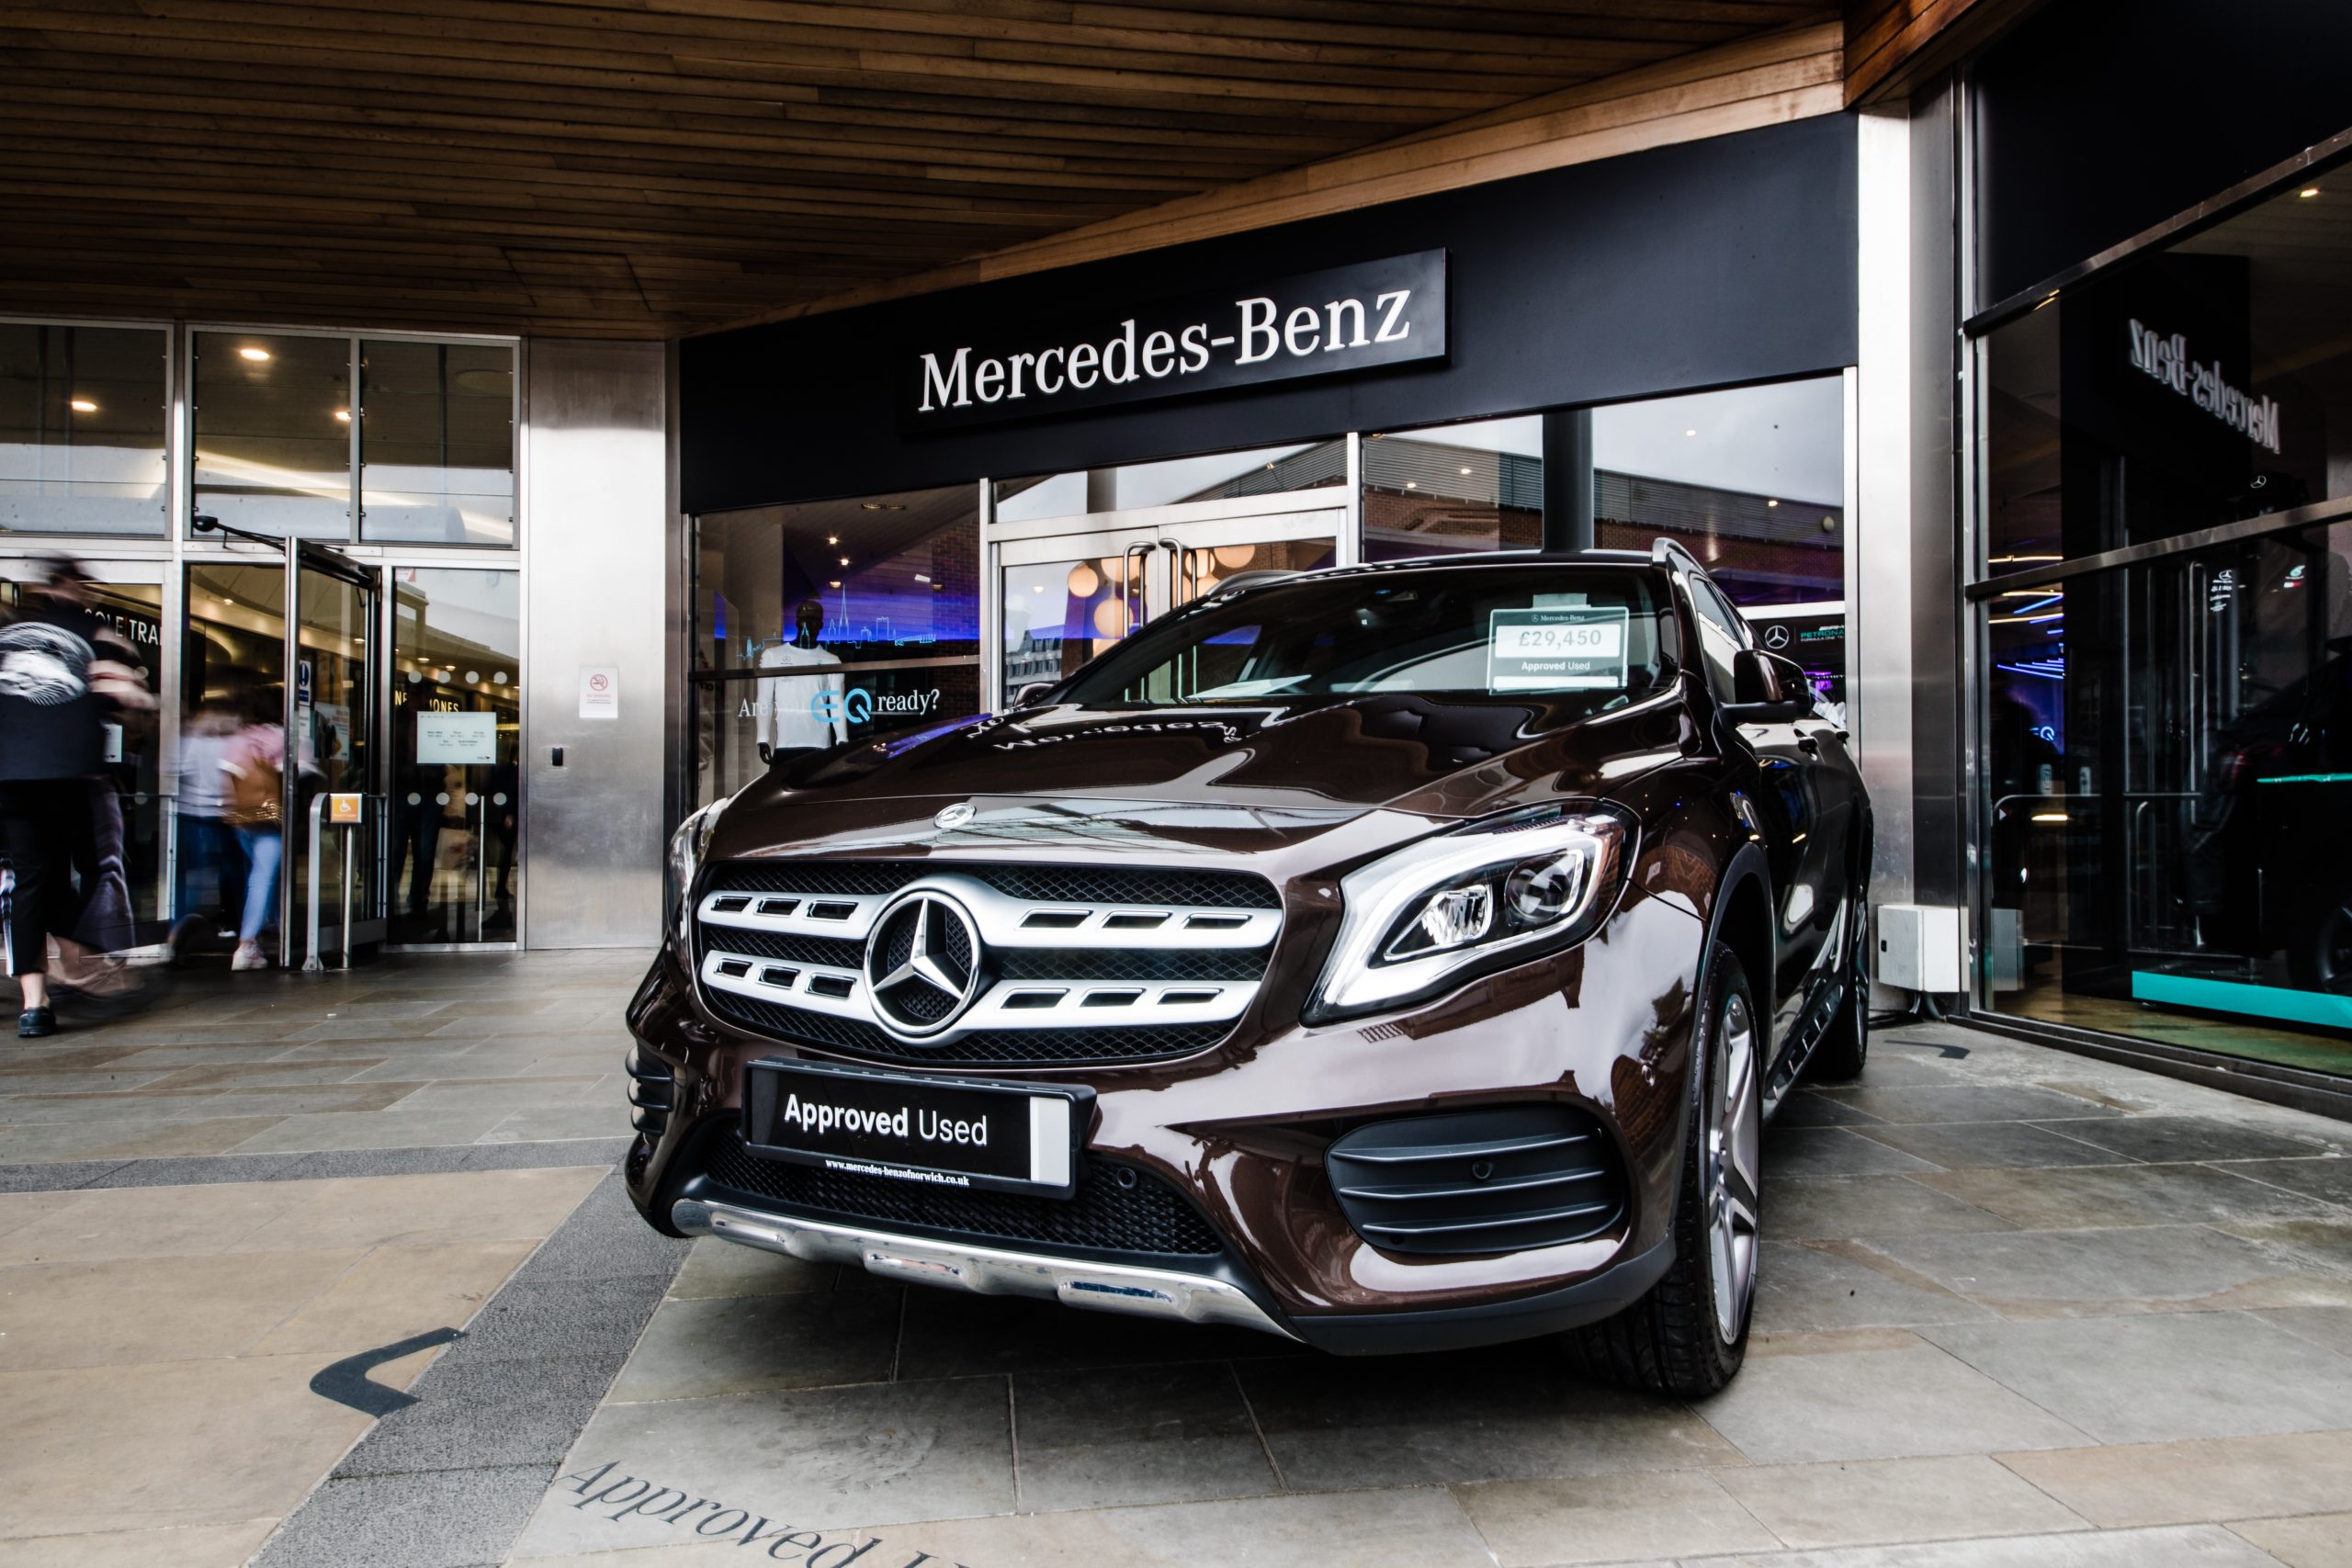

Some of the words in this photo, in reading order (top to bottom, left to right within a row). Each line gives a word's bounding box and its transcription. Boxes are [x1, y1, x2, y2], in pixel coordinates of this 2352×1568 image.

[918, 289, 1412, 412] Mercedes-Benz
[1518, 629, 1602, 650] £29,450
[1521, 660, 1566, 672] Approved
[1567, 660, 1591, 671] Used
[876, 688, 941, 716] ready?
[784, 1093, 909, 1137] Approved
[918, 1108, 988, 1147] Used
[825, 1158, 970, 1188] www.mercedes-benzofnorwich.co.uk
[551, 1460, 884, 1568] Approved
